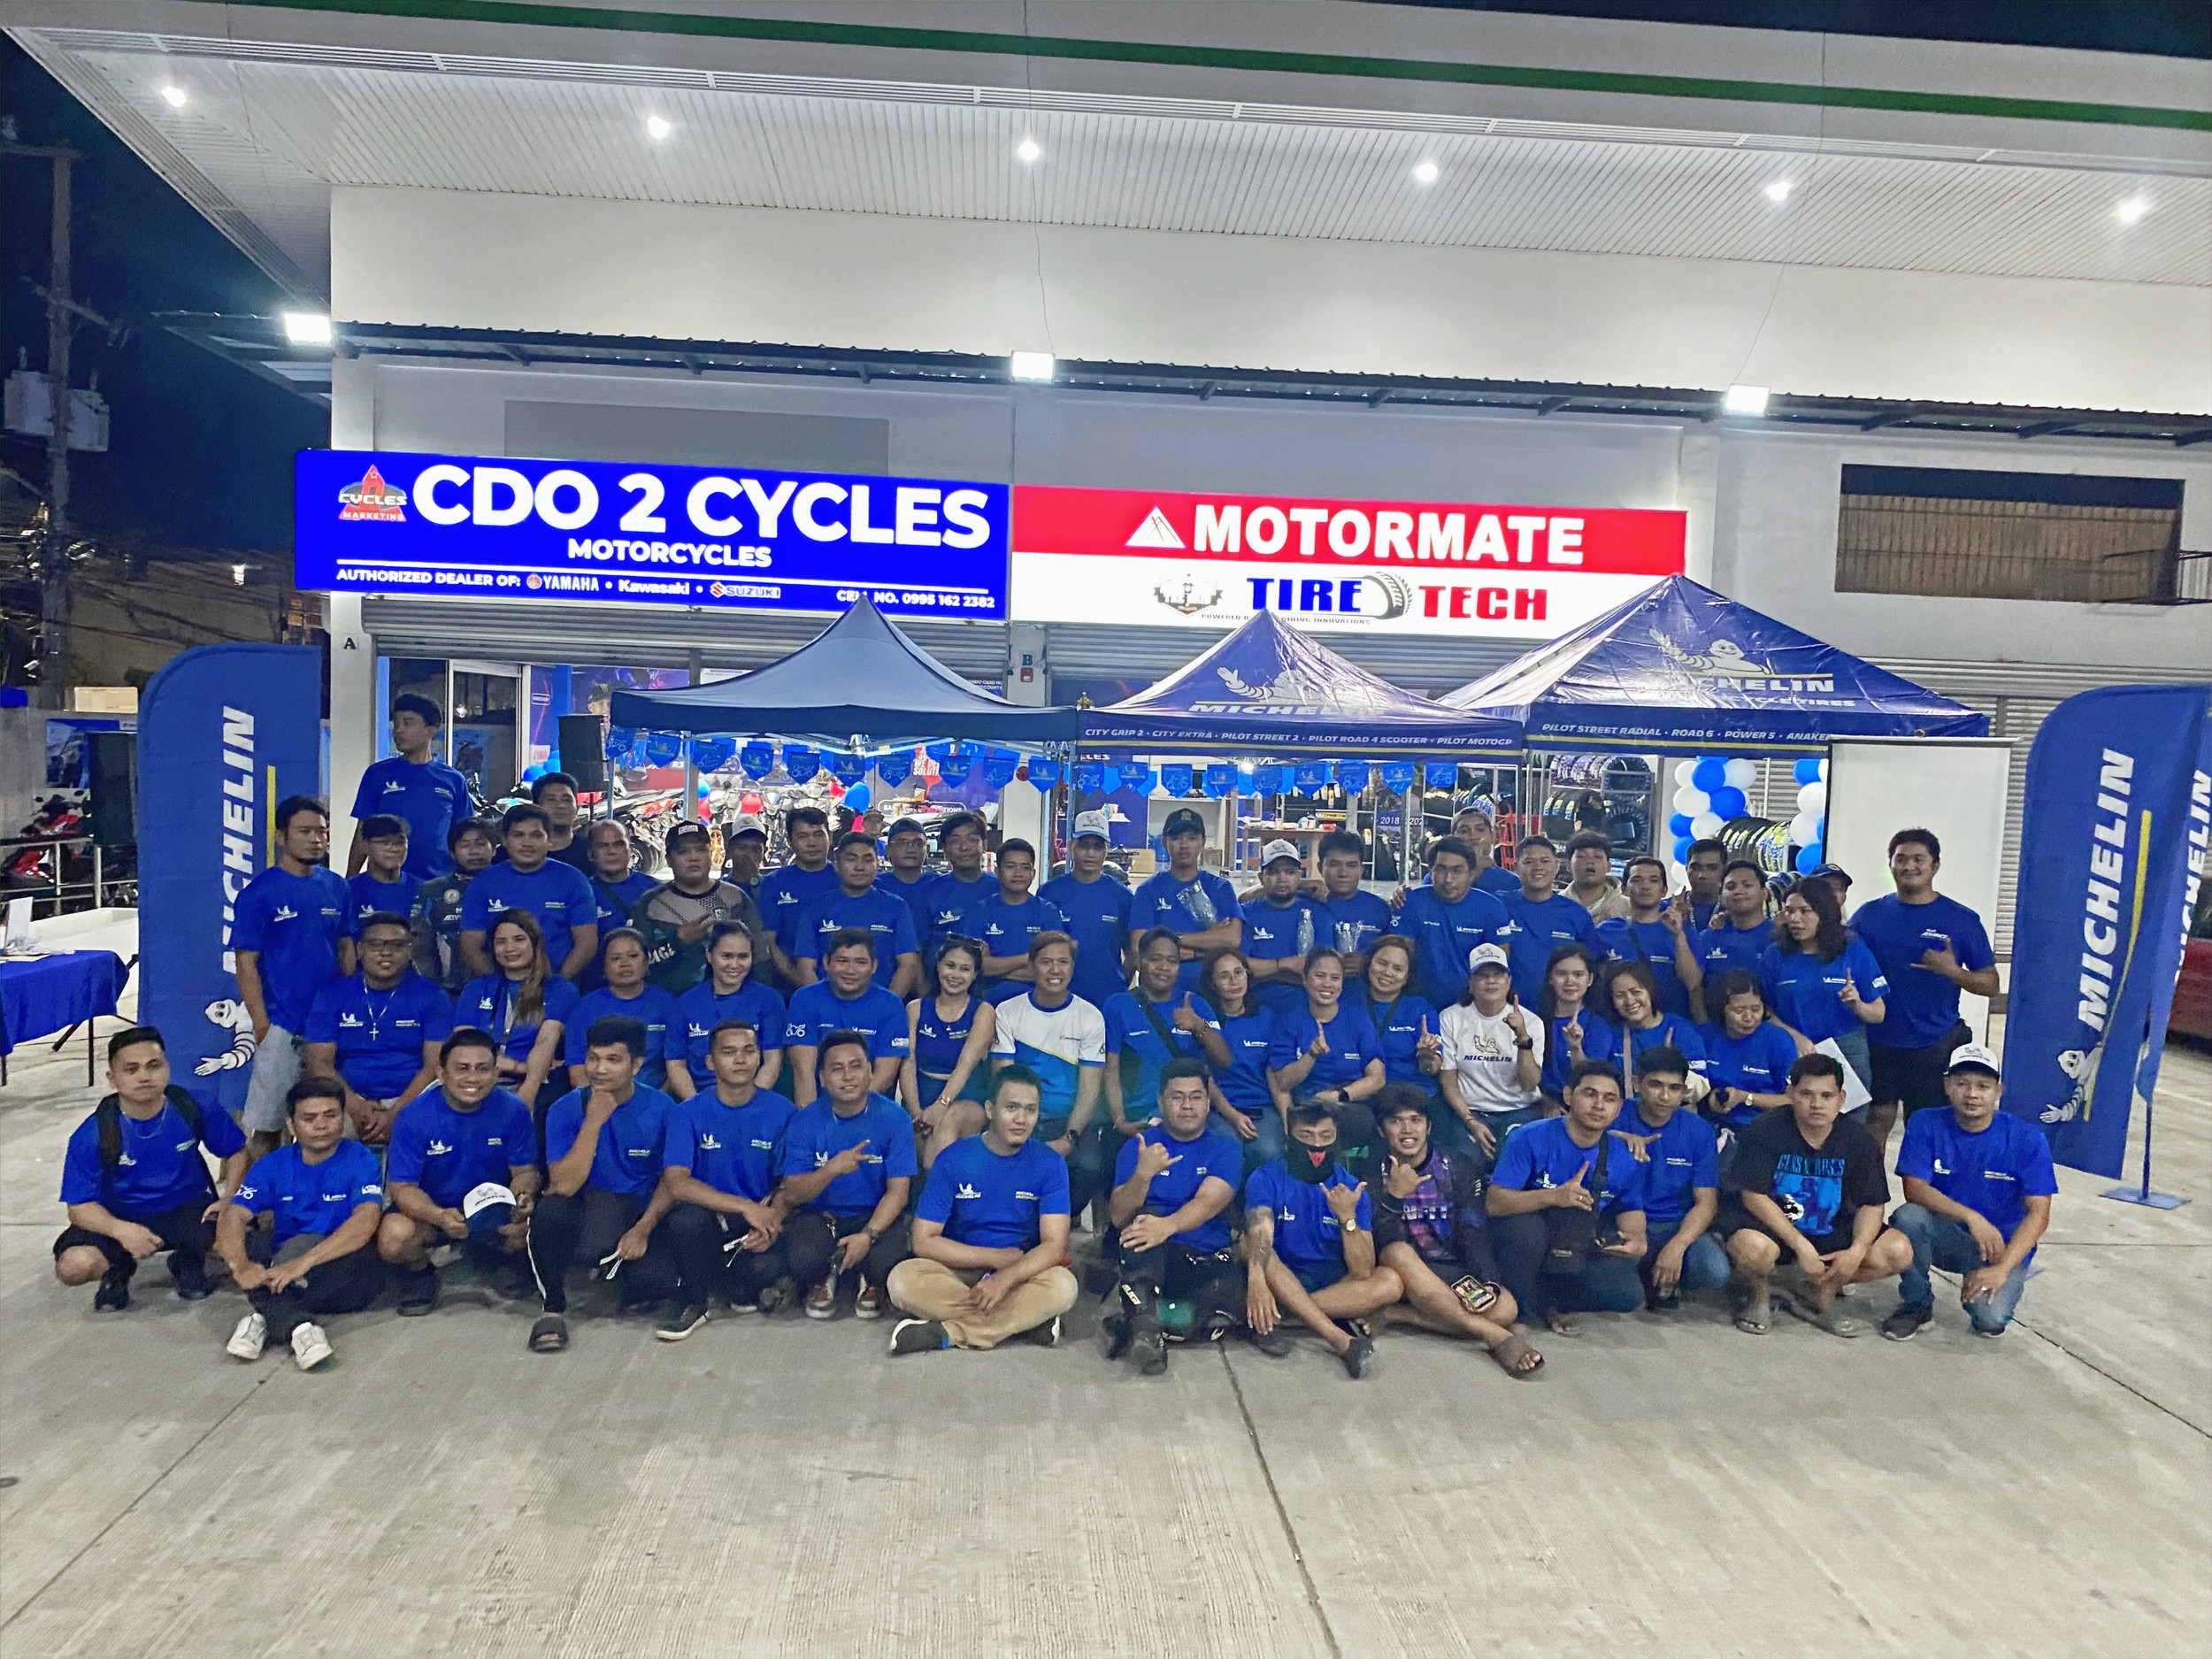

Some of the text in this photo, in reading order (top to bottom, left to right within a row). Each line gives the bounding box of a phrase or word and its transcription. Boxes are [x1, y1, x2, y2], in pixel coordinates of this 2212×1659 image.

[338, 492, 408, 506] CYCLES
[412, 464, 990, 549] CDO 2 CYCLES
[342, 511, 404, 521] MARKETING
[1194, 504, 1585, 565] MOTORMATE
[568, 538, 772, 567] MOTORCYCLES
[336, 568, 780, 599] AUTHORIZED DEALER OF: YAMAHA Kawasaki SUZUKI
[874, 591, 899, 604] NO.
[1247, 577, 1363, 612] TIRE
[1418, 585, 1548, 620] TECH
[343, 637, 357, 649] A
[1022, 654, 1033, 665] B
[1542, 723, 1577, 733] PILOT
[1576, 725, 1617, 734] STREET
[1619, 726, 1662, 736] RADIAL
[1671, 729, 1704, 738] ROAD
[1221, 732, 1253, 741] PILOT
[1467, 737, 1513, 746] MOTOGP
[1380, 816, 1401, 825] 2018
[2078, 748, 2135, 1032] MICHELIN
[1463, 1055, 1513, 1064] MICHELIN
